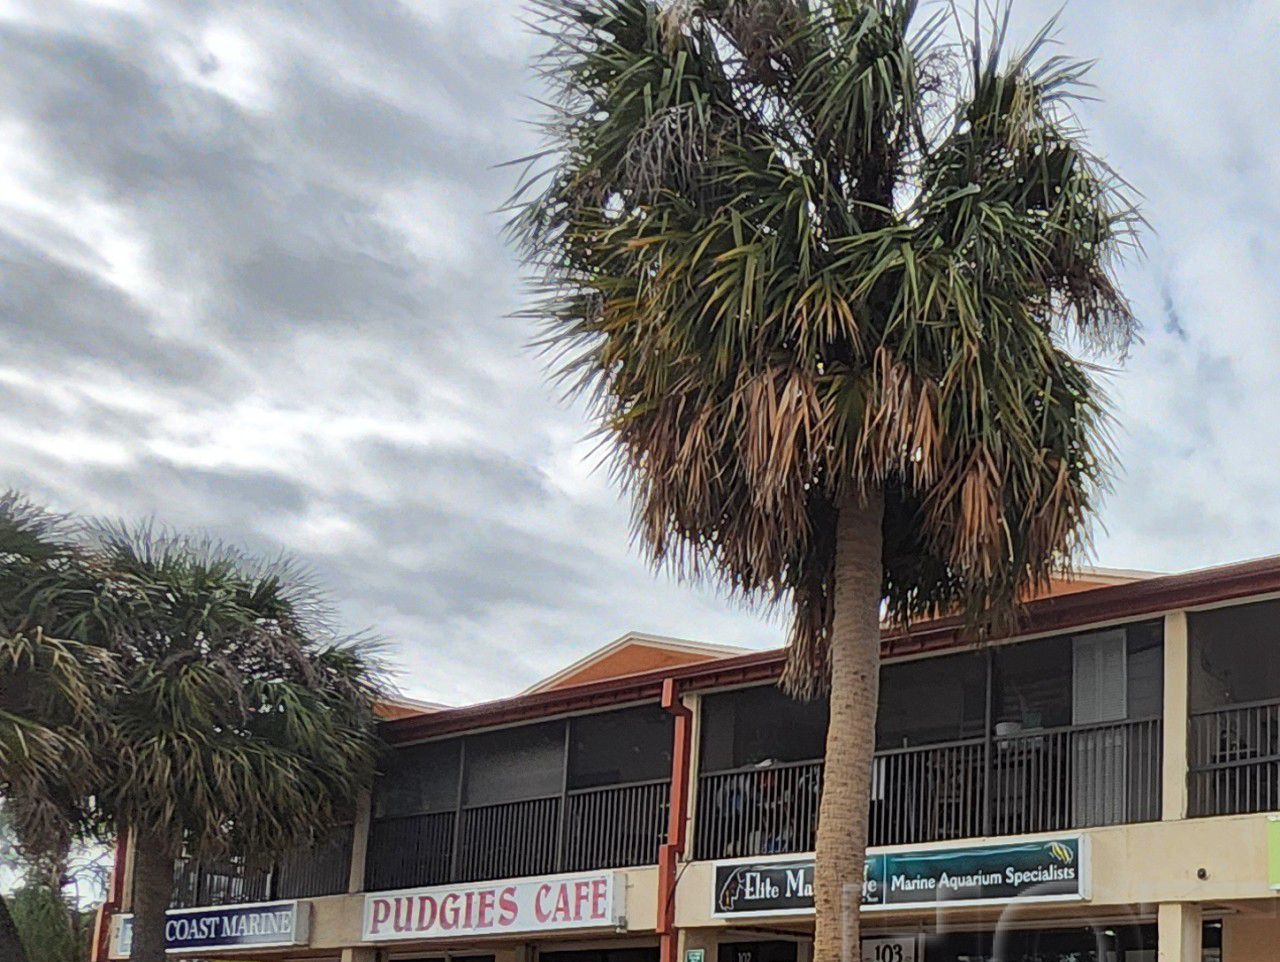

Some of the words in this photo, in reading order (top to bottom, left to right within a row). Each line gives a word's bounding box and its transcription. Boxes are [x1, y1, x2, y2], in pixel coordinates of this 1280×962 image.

[744, 871, 779, 900] Elite
[891, 873, 936, 892] Marine
[938, 869, 1002, 890] Aquarium
[1005, 863, 1075, 887] Specialists
[370, 886, 518, 934] PUDGIES
[535, 879, 607, 923] CAFE
[165, 917, 220, 942] COAST
[221, 911, 292, 938] MARINE
